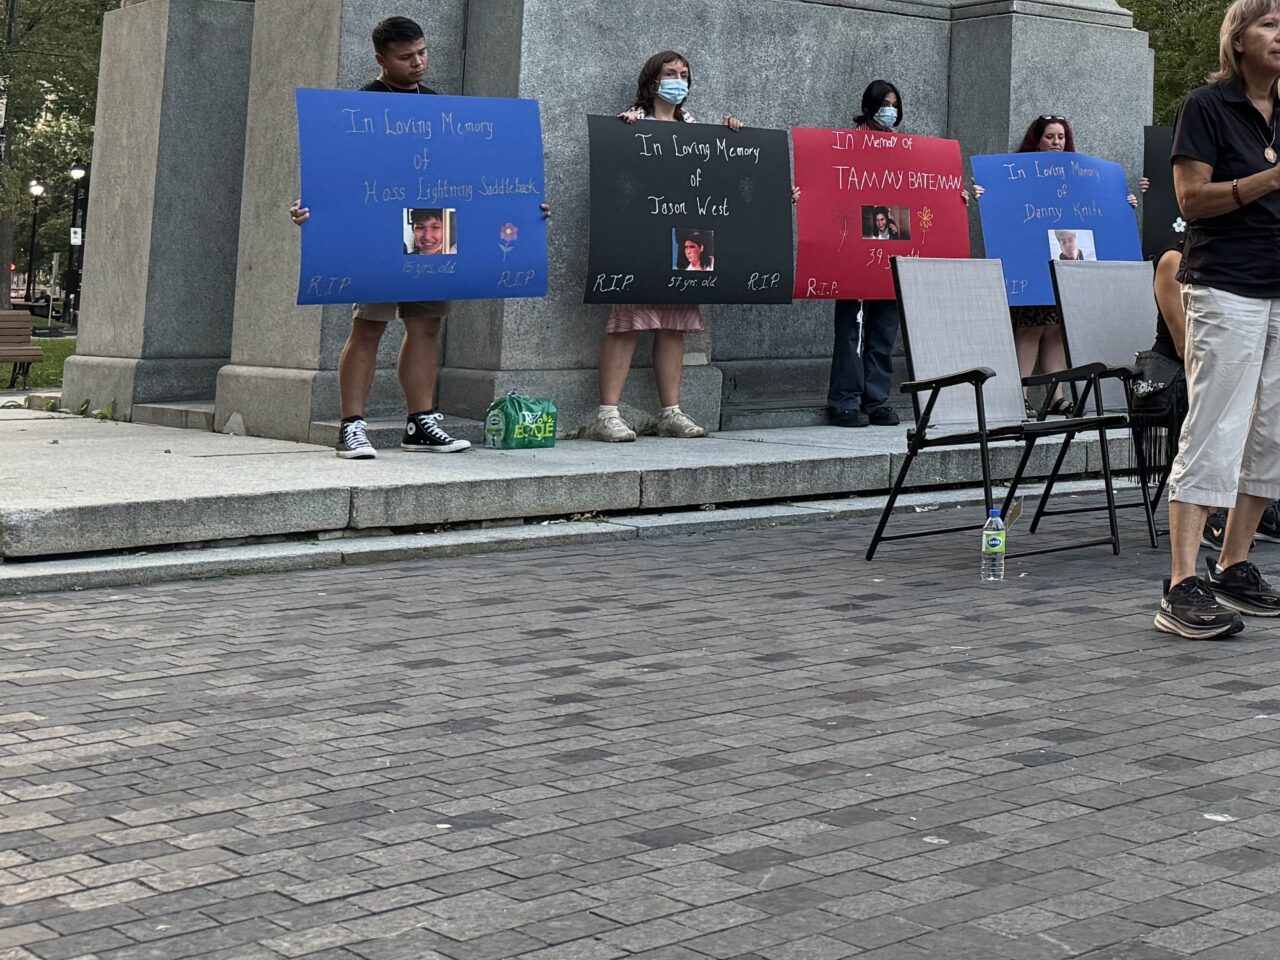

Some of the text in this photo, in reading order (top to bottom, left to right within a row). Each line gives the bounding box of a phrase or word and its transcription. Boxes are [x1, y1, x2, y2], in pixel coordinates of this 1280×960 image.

[342, 107, 494, 139] In Loving Memory
[635, 133, 761, 164] In Loving Memory
[832, 131, 854, 150] In
[413, 147, 431, 170] of
[690, 168, 702, 187] of
[832, 165, 962, 191] TAMMY BATEMAN
[1002, 160, 1100, 182] In Loving Memory
[364, 176, 540, 204] Hoss Lightning Saddleback
[1057, 184, 1068, 199] of
[647, 195, 730, 216] Jason West
[1022, 203, 1063, 224] Danny
[866, 248, 883, 267] 39
[667, 276, 682, 287] 57
[701, 276, 718, 287] old
[1005, 279, 1029, 294] IP
